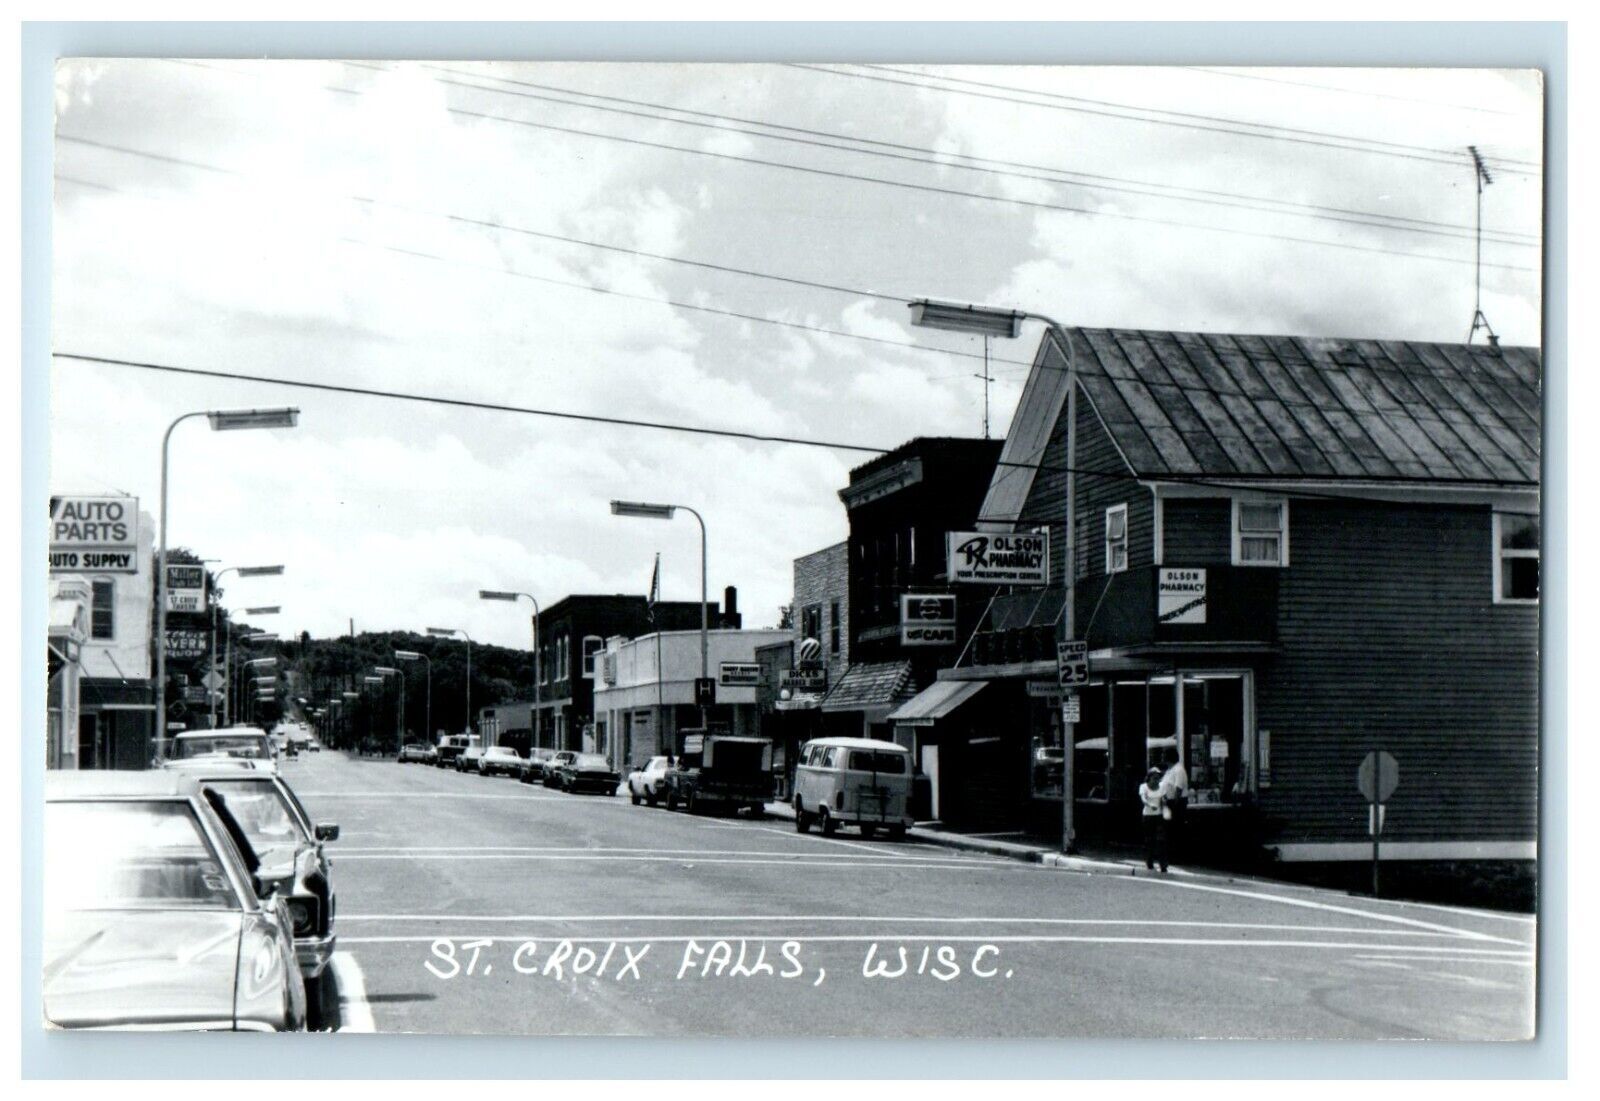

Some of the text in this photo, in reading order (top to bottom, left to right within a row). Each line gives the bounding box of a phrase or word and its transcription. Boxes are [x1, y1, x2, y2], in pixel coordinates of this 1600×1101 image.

[61, 501, 124, 521] AUTO
[55, 522, 128, 541] PARTS
[993, 537, 1043, 552] OLSON
[83, 552, 130, 568] SUPPLY
[989, 551, 1043, 568] PHARMACY
[957, 570, 1042, 580] YOUR PRESCRIPTION CENTER
[1167, 571, 1199, 581] OLSON
[1160, 583, 1205, 592] PHARMACY
[1059, 643, 1086, 653] SPEED
[1062, 653, 1084, 662] LIMIT
[1060, 664, 1088, 683] 25
[700, 682, 711, 696] H
